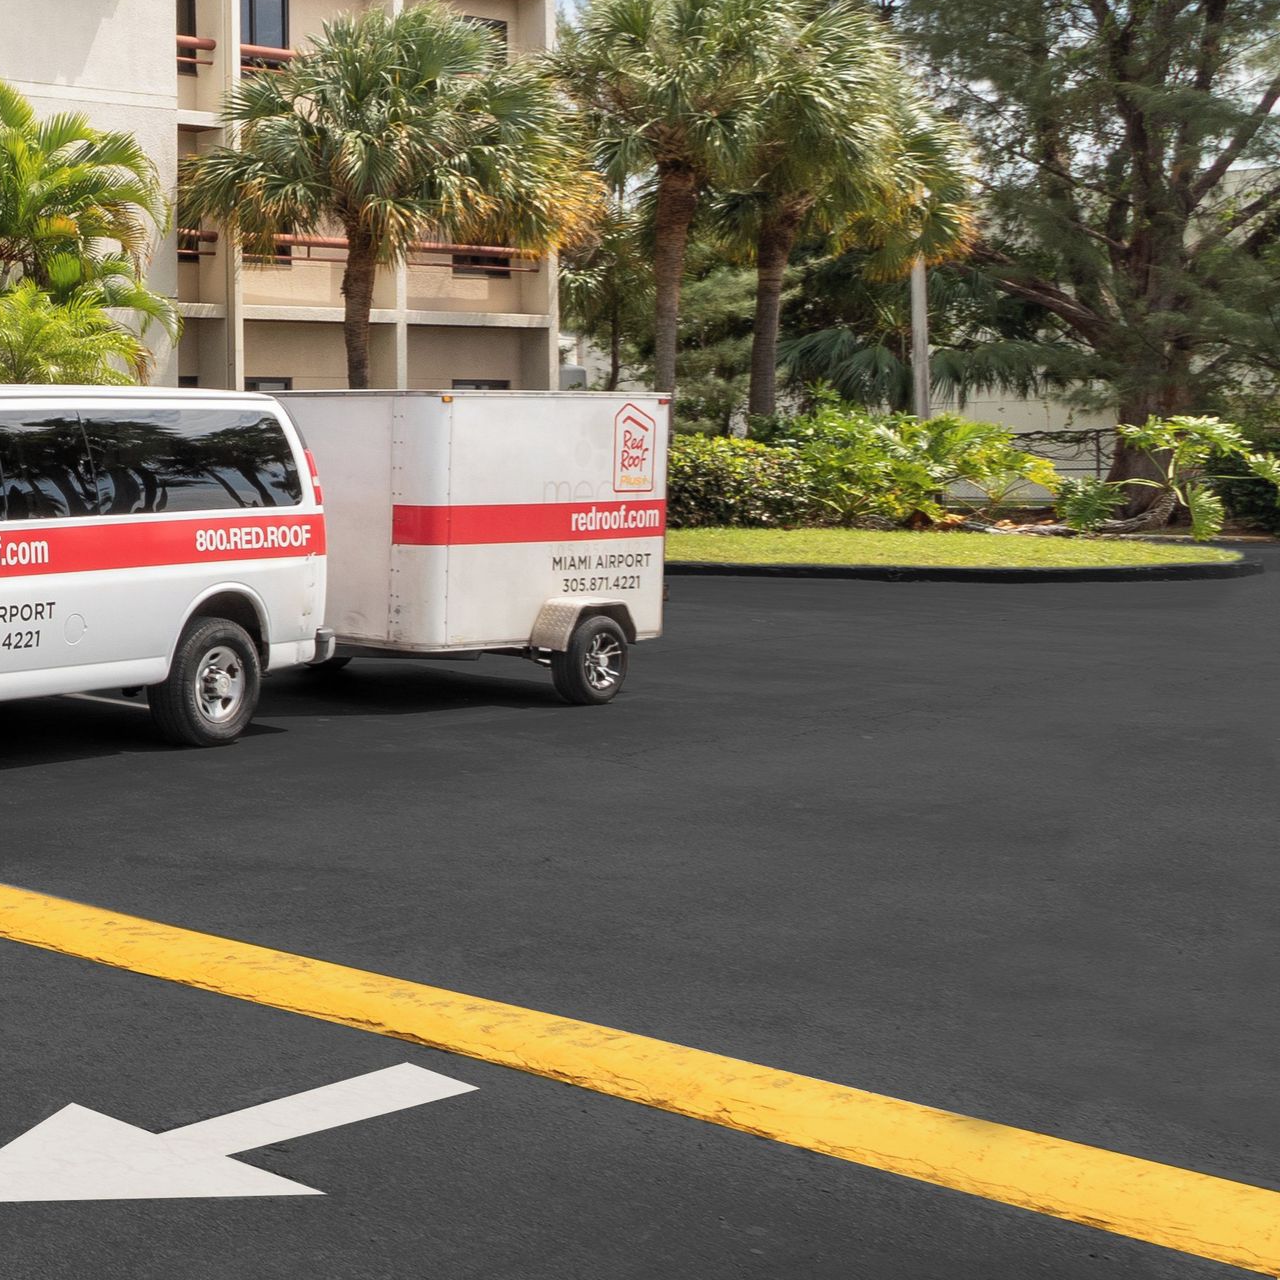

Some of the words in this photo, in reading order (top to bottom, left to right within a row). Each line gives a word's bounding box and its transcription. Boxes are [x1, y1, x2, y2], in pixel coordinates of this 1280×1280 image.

[623, 430, 645, 450] Red
[621, 448, 649, 472] Roof
[571, 504, 659, 531] redroof.com
[195, 525, 311, 551] 800.RED.ROOF
[552, 556, 592, 571] MIAMI
[595, 553, 652, 569] AIRPORT
[562, 575, 641, 592] 305.871.4221
